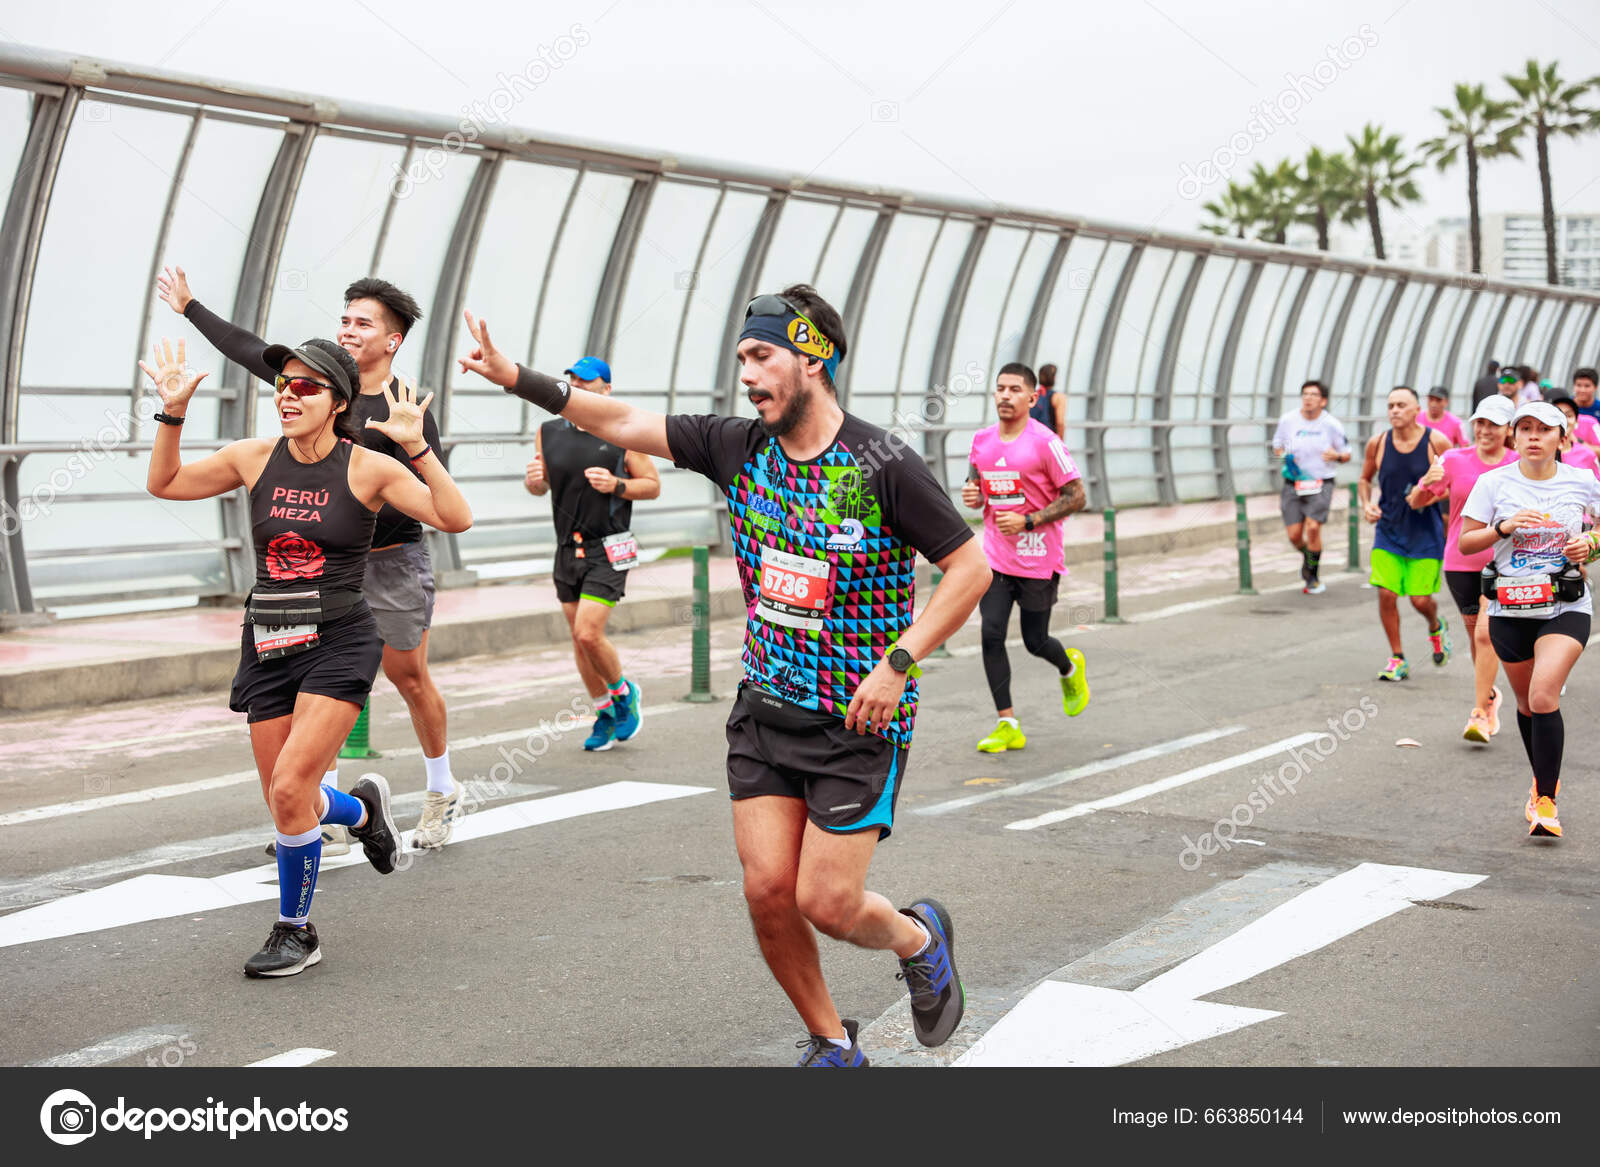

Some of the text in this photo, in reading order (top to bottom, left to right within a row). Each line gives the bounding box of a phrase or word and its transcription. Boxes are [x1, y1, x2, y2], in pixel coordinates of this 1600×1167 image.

[272, 486, 330, 507] PERÚ
[269, 505, 323, 523] MEZA
[826, 542, 864, 552] coach
[1016, 532, 1047, 549] 21K
[763, 567, 809, 599] 5736
[1506, 586, 1544, 601] 3622
